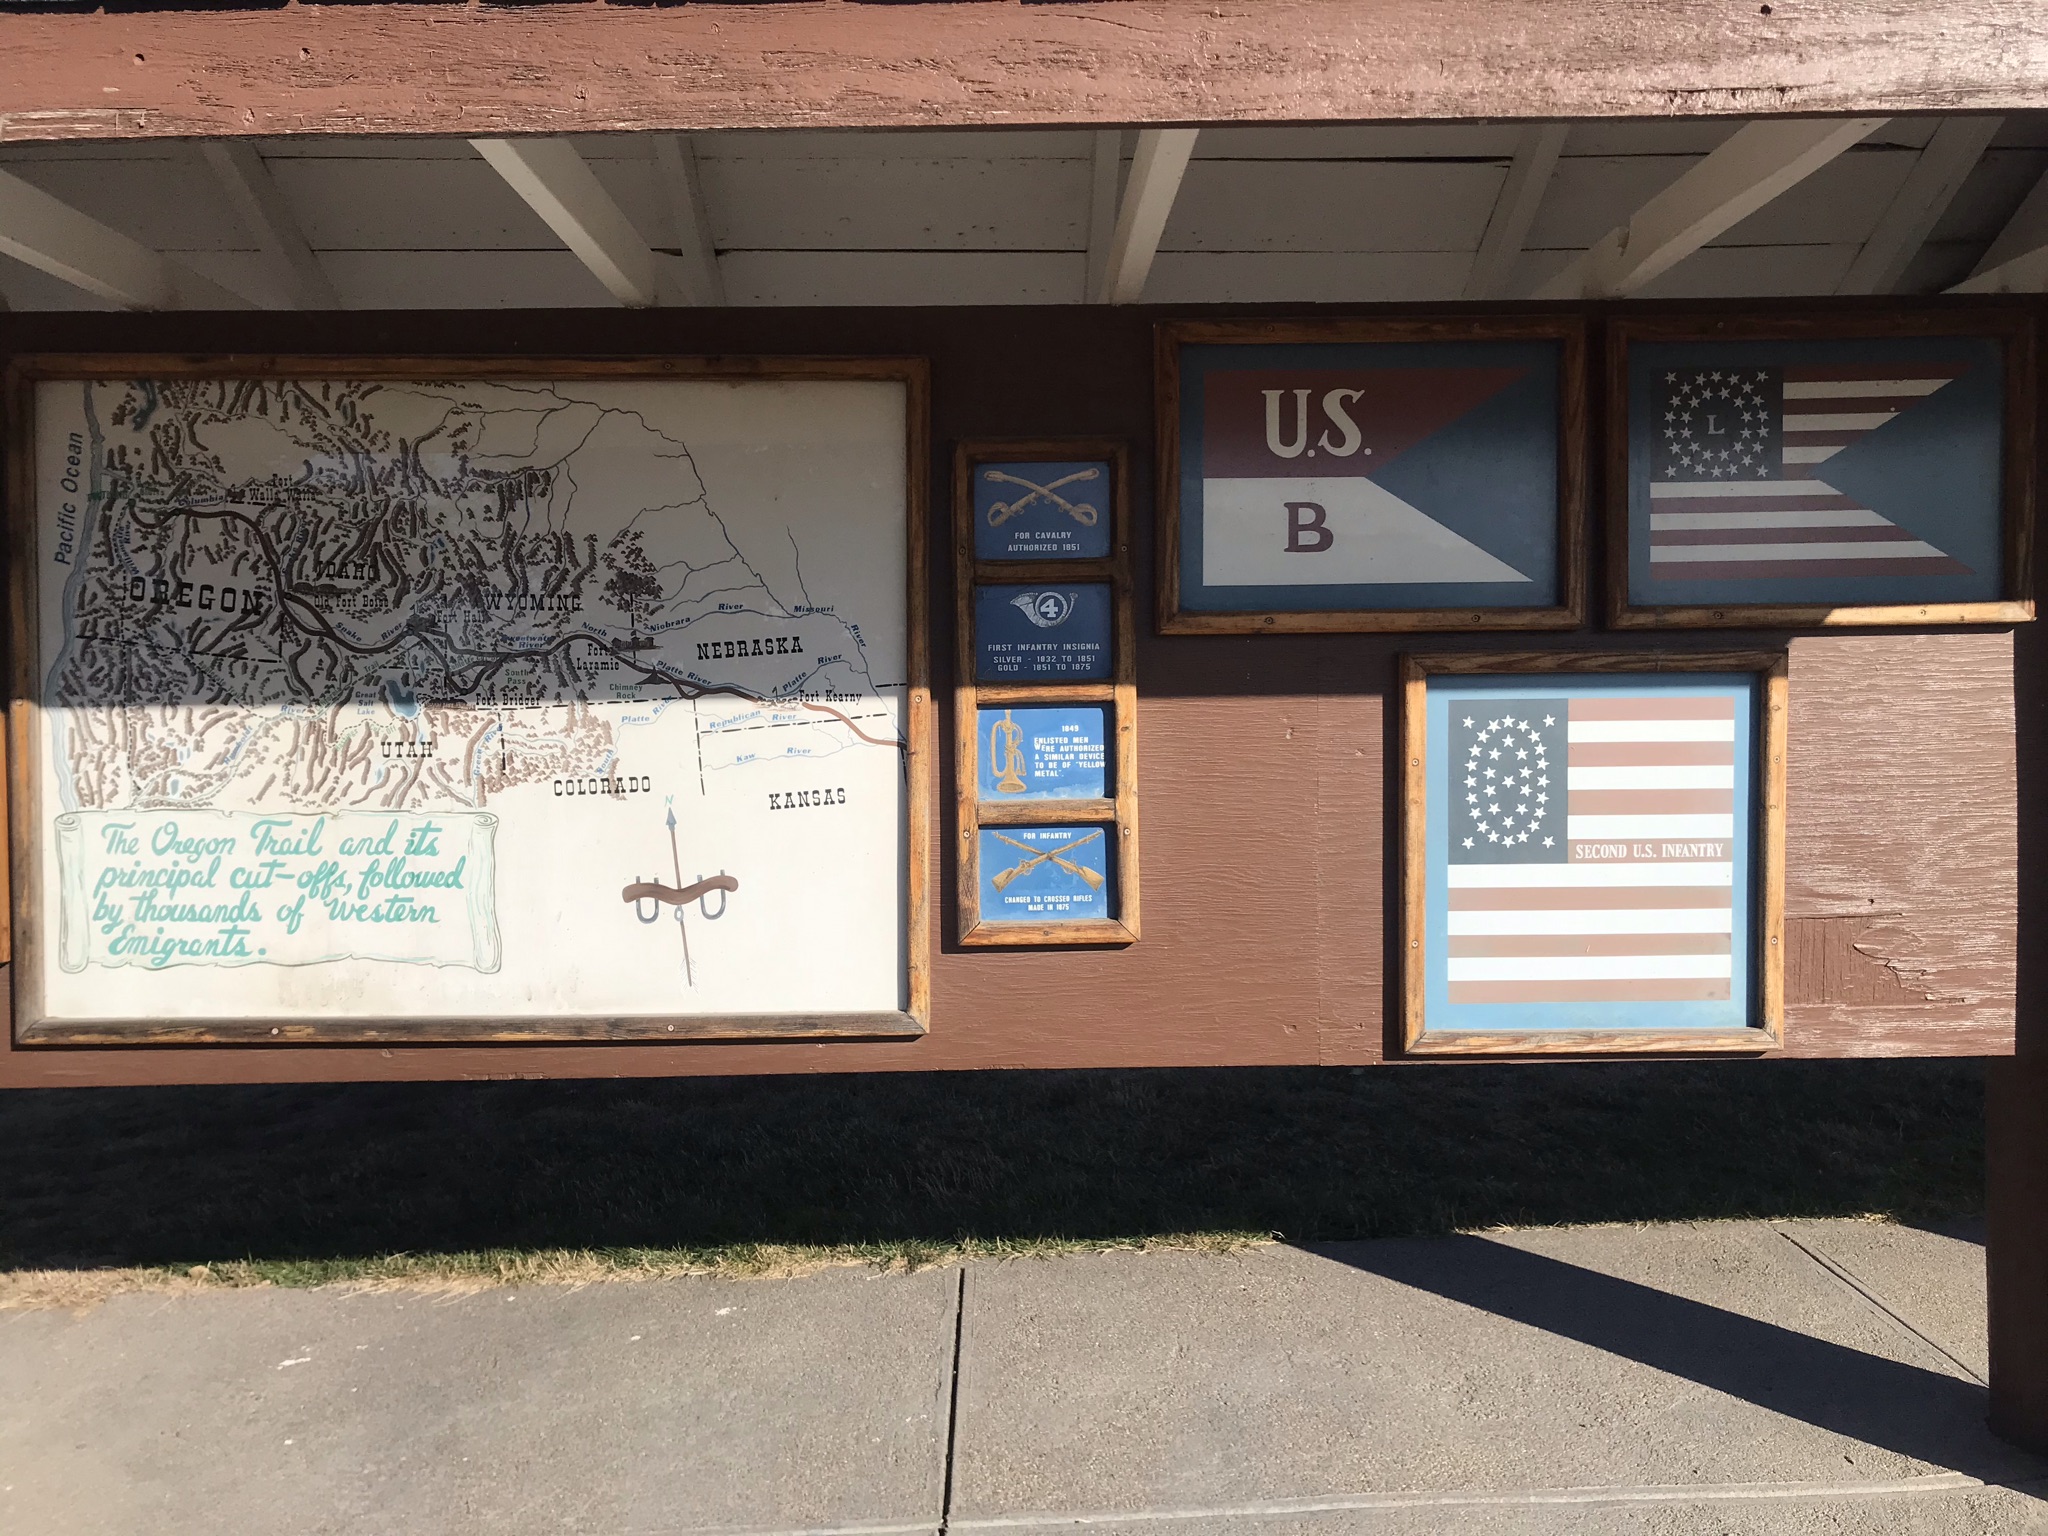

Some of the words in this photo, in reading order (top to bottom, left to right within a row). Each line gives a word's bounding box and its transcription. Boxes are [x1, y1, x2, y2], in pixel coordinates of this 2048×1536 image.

[1261, 388, 1372, 458] U.S.
[1706, 414, 1725, 435] L
[62, 431, 83, 493] Ocean
[54, 505, 77, 566] Pacific
[1014, 532, 1031, 540] FOR
[1035, 531, 1072, 540] CAVALRY
[1283, 502, 1334, 553] B
[1007, 544, 1058, 552] AUTHORIZED
[1062, 543, 1081, 551] 1851
[317, 561, 377, 580] IDAHO
[130, 576, 263, 615] OREGON
[336, 595, 357, 608] Fort
[485, 593, 582, 611] WYOMING
[794, 604, 835, 614] Missouri
[1039, 598, 1059, 618] 4
[649, 617, 691, 632] Niobrara
[718, 602, 744, 611] River
[335, 621, 363, 642] Snake
[380, 622, 403, 641] River
[582, 622, 608, 637] North
[851, 623, 867, 648] River
[518, 641, 545, 649] River
[697, 636, 804, 661] NEBRASKA
[987, 644, 1013, 652] FIRST
[1017, 643, 1058, 652] INFANTRY
[1063, 643, 1101, 652] INSIGNIA
[577, 658, 620, 671] Laramie
[993, 655, 1022, 664] SILVER
[1061, 655, 1073, 663] TO
[1077, 654, 1096, 662] 1851
[363, 661, 380, 674] Trail
[656, 660, 684, 676] Platte
[687, 672, 712, 686] River
[782, 671, 807, 692] Platte
[817, 654, 843, 666] River
[997, 663, 1019, 672] GOLD
[1032, 663, 1051, 671] 1851
[1055, 663, 1067, 671] TO
[1071, 663, 1091, 671] 1875
[355, 691, 376, 699] Great
[610, 684, 643, 692] Chimney
[503, 693, 540, 706] Bridger
[799, 690, 822, 702] Fort
[825, 690, 862, 704] Kearny
[281, 705, 305, 714] River
[709, 710, 761, 729] Republican
[772, 713, 797, 721] River
[1061, 725, 1079, 733] 1849
[595, 748, 614, 774] South
[621, 715, 650, 723] Platte
[1034, 737, 1069, 745] ENLISTED
[1034, 743, 1056, 753] WERE
[1059, 744, 1105, 752] AUTHORIZED
[381, 741, 433, 758] UTAH
[736, 752, 756, 763] Kaw
[786, 747, 811, 755] River
[1034, 752, 1040, 760] A
[1043, 752, 1075, 761] SIMILAR
[1079, 752, 1105, 760] DEVICE
[473, 748, 482, 776] Green
[1034, 761, 1044, 769] TO
[1048, 761, 1059, 769] BE
[1061, 761, 1072, 769] OF
[554, 775, 651, 797] COLORADO
[664, 794, 674, 806] N
[769, 788, 846, 811] KANSAS
[101, 821, 140, 856] The
[151, 821, 237, 863] Oregon
[250, 816, 323, 856] Trail
[339, 818, 394, 856] and
[405, 821, 443, 856] its
[1023, 832, 1036, 840] FOR
[1039, 832, 1072, 840] INFANTRY
[1575, 844, 1627, 859] SECOND
[1633, 843, 1657, 858] U.S.
[1661, 843, 1724, 858] INFANTRY
[94, 856, 219, 900] principal
[230, 861, 352, 901] cut-offs,
[358, 855, 467, 899] followed
[1004, 896, 1031, 904] CHANGED
[1033, 895, 1042, 904] TO
[1043, 895, 1070, 903] CROSSED
[1073, 894, 1092, 903] RIFLES
[93, 891, 123, 934] by
[129, 890, 262, 924] thousands
[276, 897, 307, 934] of
[1028, 903, 1044, 912] MADE
[1047, 903, 1054, 911] IN
[1056, 903, 1070, 911] 1875
[109, 925, 267, 966] Emigrants.
